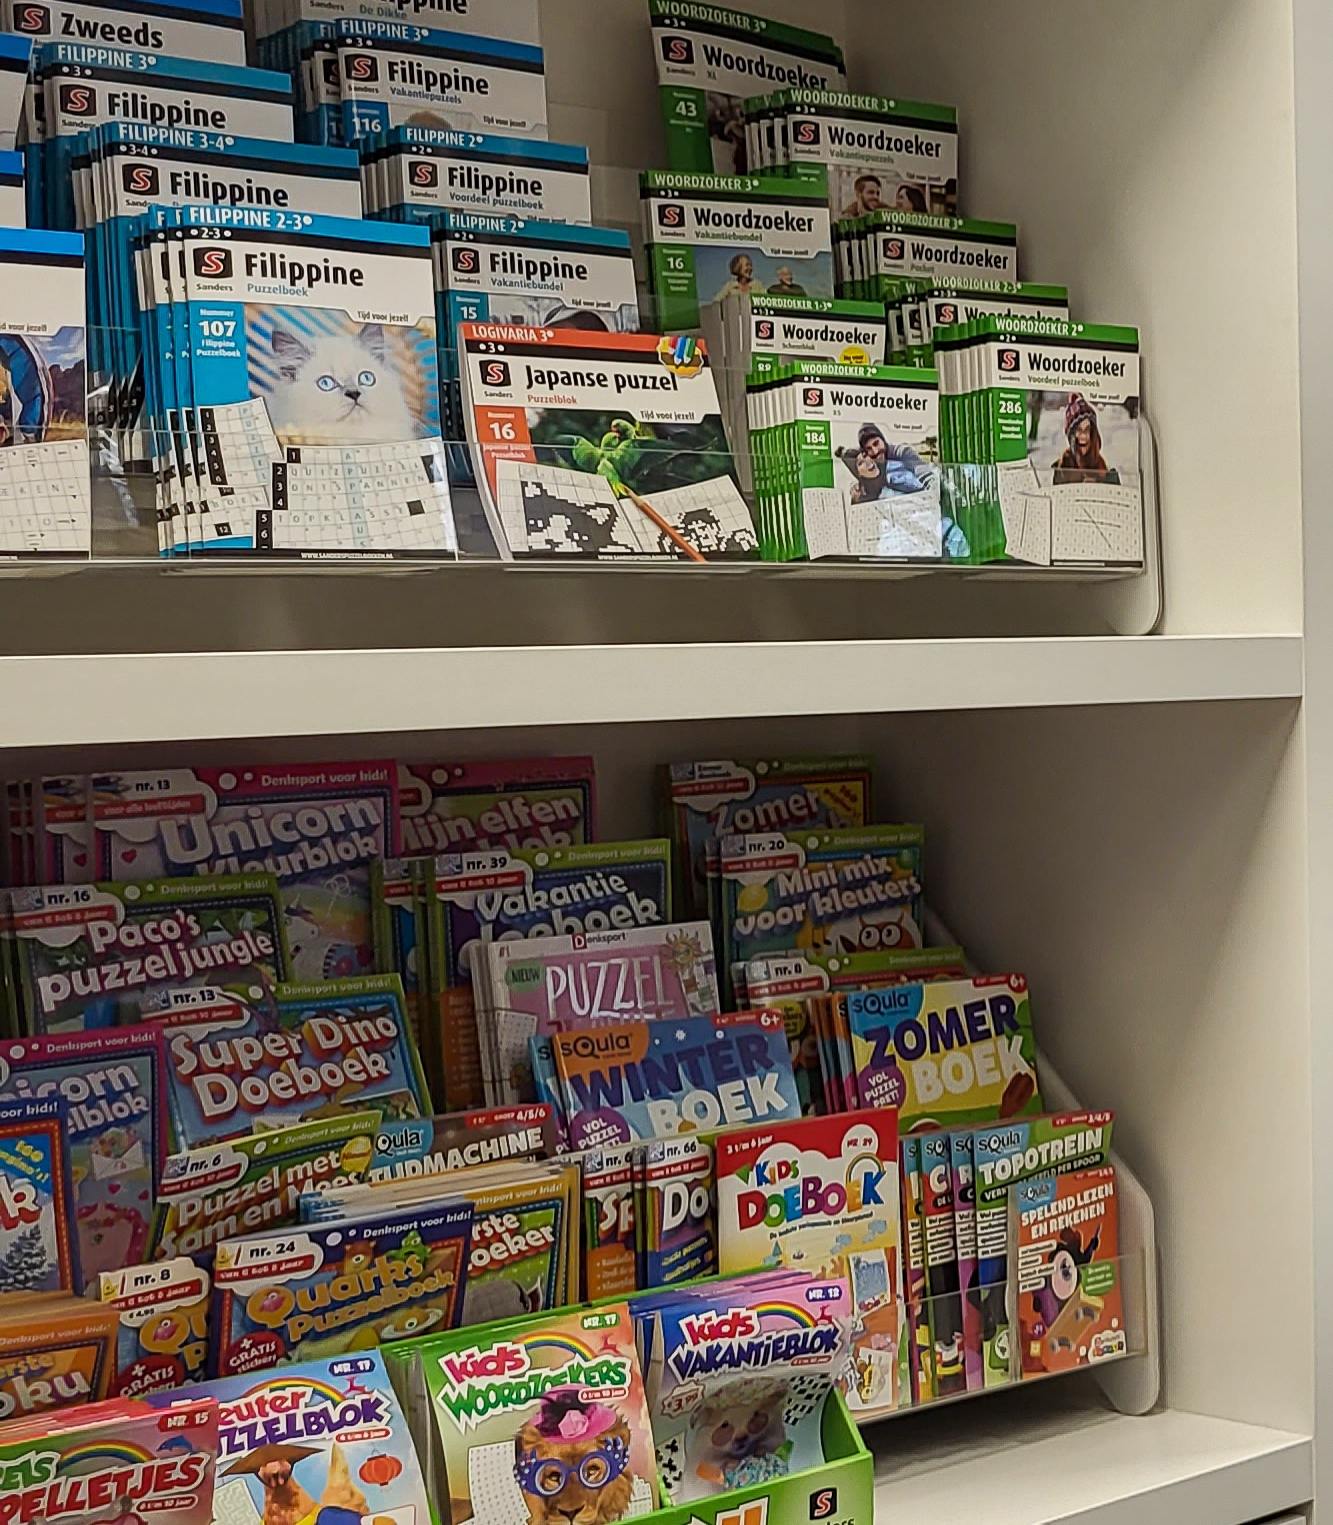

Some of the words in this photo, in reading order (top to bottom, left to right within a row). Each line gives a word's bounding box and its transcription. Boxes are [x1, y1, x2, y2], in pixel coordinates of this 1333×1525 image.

[656, 0, 751, 30] WOORDZOEKER
[61, 12, 163, 49] Zweeds
[341, 20, 409, 39] FILIPPINE
[57, 44, 133, 69] FILIPPINE
[702, 44, 828, 90] Woordzoeker
[388, 61, 489, 95] Filippine
[107, 92, 227, 130] Filippine
[675, 101, 697, 117] 43
[790, 88, 878, 110] WOORDZOEKER
[118, 124, 195, 147] FILIPPINE
[352, 117, 381, 133] 116
[407, 128, 464, 146] FILIPPINE
[828, 125, 941, 158] Woordzoeker
[170, 171, 289, 207] Filippine
[448, 166, 543, 197] Filippine
[654, 173, 742, 190] WOORDZOEKER
[449, 192, 490, 205] Voordeel
[492, 197, 543, 211] puzzelboek
[189, 209, 270, 227] FILIPPINE
[450, 214, 506, 232] FILIPPINE
[693, 207, 814, 233] Woordzoeker
[881, 211, 950, 229] WOORDZOEKER
[201, 228, 221, 239] 2-3
[490, 252, 588, 281] Filippine
[667, 257, 684, 269] 16
[911, 242, 1009, 270] Woordzoeker
[245, 252, 364, 288] Filippine
[196, 283, 233, 292] Sanders
[247, 283, 308, 297] Puzzelboek
[490, 277, 564, 291] Vakantiebundel
[460, 307, 478, 320] 15
[199, 320, 236, 338] 107
[471, 325, 537, 342] LOGIVARIA
[782, 324, 878, 345] Woordzoeker
[996, 317, 1069, 335] WOORDZOEKER
[1028, 352, 1126, 377] Woordzoeker
[525, 365, 608, 390] Japanse
[614, 372, 678, 393] puzzel
[527, 394, 578, 405] Puzzelblok
[830, 391, 928, 411] Woordzoeker
[999, 401, 1022, 413] 286
[489, 422, 515, 440] 16
[804, 432, 826, 444] 184
[136, 781, 154, 791] nr.
[157, 780, 170, 790] 13
[479, 796, 580, 834] elfen
[715, 788, 820, 837] Zomer
[160, 799, 380, 864] Unicorn
[749, 841, 766, 852] nr.
[769, 839, 784, 850] 20
[466, 860, 487, 870] nr.
[490, 856, 507, 869] 39
[777, 864, 837, 897] Mini
[842, 853, 892, 881] mix
[48, 894, 70, 905] nr.
[74, 891, 90, 902] 16
[476, 872, 628, 922] Vakantie
[735, 902, 807, 935] voor
[815, 876, 921, 917] kleuters
[87, 908, 201, 953] Paco's
[511, 969, 540, 983] NIEUW
[546, 956, 673, 1019] PUZZEL
[173, 993, 197, 1005] nr.
[199, 990, 215, 1002] 13
[864, 995, 1020, 1070] ZOMER
[170, 1032, 302, 1075] Super
[307, 1016, 398, 1049] Dino
[193, 1046, 390, 1117] Doeboek
[571, 1034, 774, 1111] WINTER
[868, 1072, 888, 1087] VOL
[911, 1035, 1030, 1105] BOEK
[864, 1079, 900, 1101] PUZZEL
[648, 1072, 788, 1136] BOEK
[577, 1125, 622, 1149] PUZZEL
[582, 1117, 607, 1133] VOL
[666, 1145, 681, 1156] nr.
[684, 1142, 697, 1154] 66
[979, 1128, 1102, 1184] TOPOTREIN
[190, 1160, 209, 1171] nr.
[179, 1166, 280, 1227] Puzzel
[287, 1151, 340, 1184] met
[737, 1171, 886, 1231] DOEBOEK
[244, 1197, 283, 1226] en
[1021, 1197, 1075, 1226] SPELEND
[1077, 1183, 1114, 1206] LEZEN
[421, 1216, 443, 1228] voor
[446, 1211, 472, 1225] kids!
[1031, 1223, 1047, 1239] EN
[1049, 1203, 1105, 1233] REKENEN
[250, 1248, 271, 1258] nr.
[275, 1241, 295, 1255] 24
[134, 1272, 156, 1287] nr.
[160, 1269, 171, 1281] 8
[247, 1252, 423, 1328] Quarks
[288, 1269, 455, 1342] Puzzelboek
[229, 1341, 277, 1368] GRATIS
[673, 1326, 840, 1380] VAKANTIEBLOK
[441, 1360, 627, 1421] WOORDZOEKERS
[0, 1457, 205, 1525] PELLETJES
